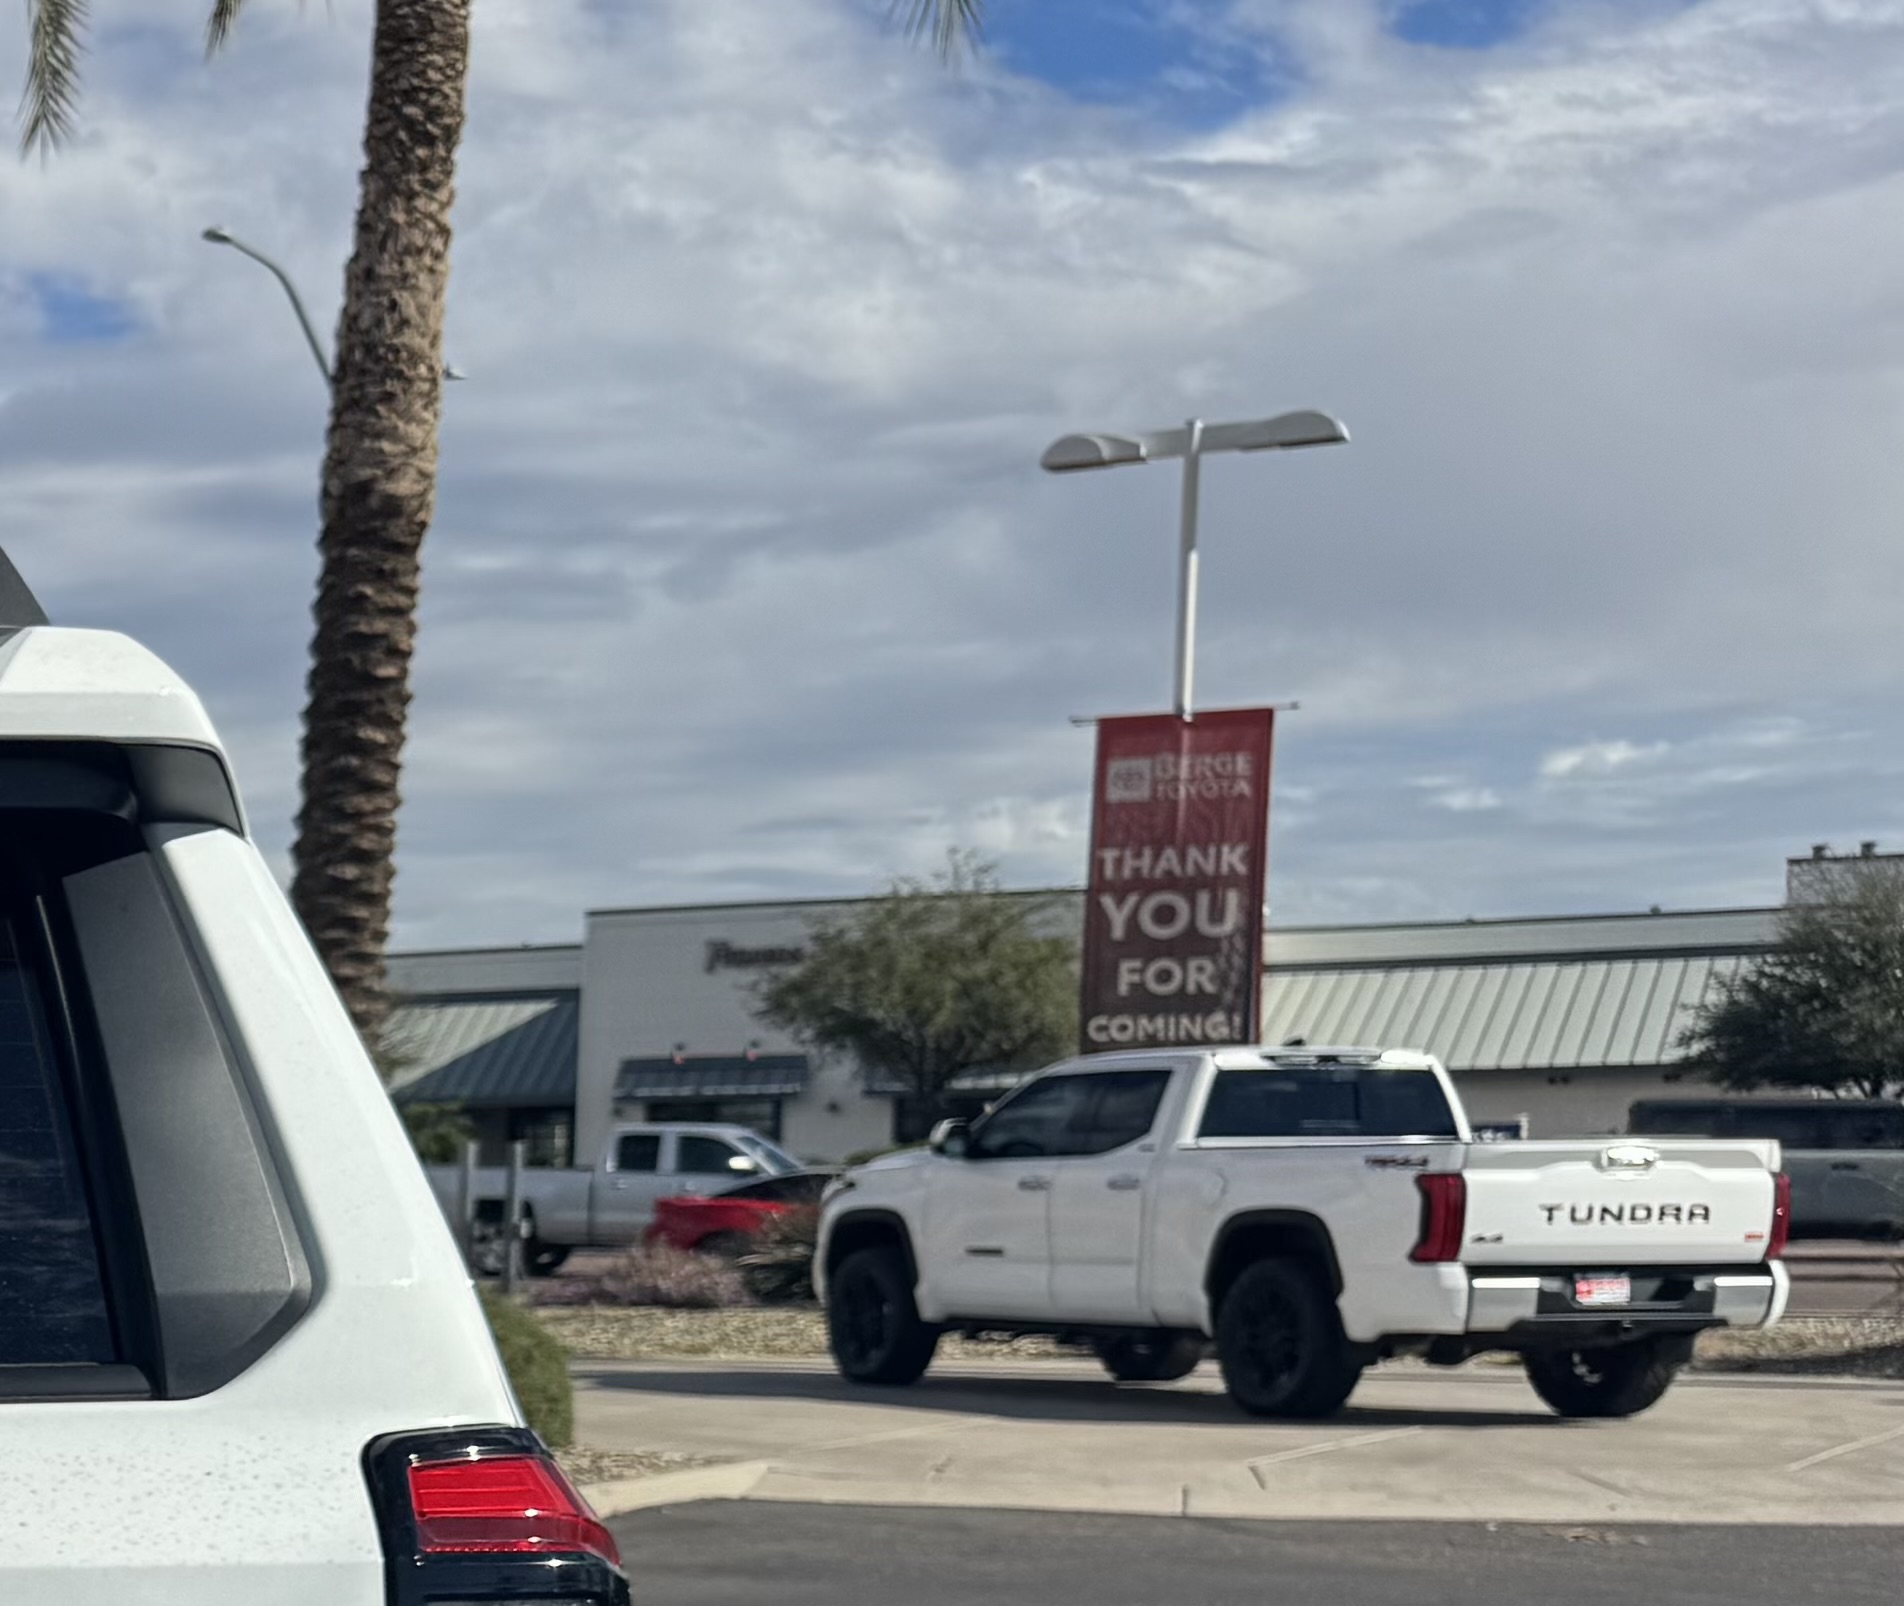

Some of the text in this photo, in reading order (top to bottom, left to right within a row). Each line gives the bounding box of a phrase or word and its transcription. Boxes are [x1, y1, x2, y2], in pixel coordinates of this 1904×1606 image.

[1155, 753, 1252, 779] BERGE
[1156, 778, 1252, 800] TOYOTA
[1098, 844, 1249, 880] THANK
[1100, 888, 1241, 941] YOU
[1116, 957, 1218, 996] FOR
[1087, 1013, 1242, 1043] COMING!
[1539, 1203, 1711, 1226] TUNDRA
